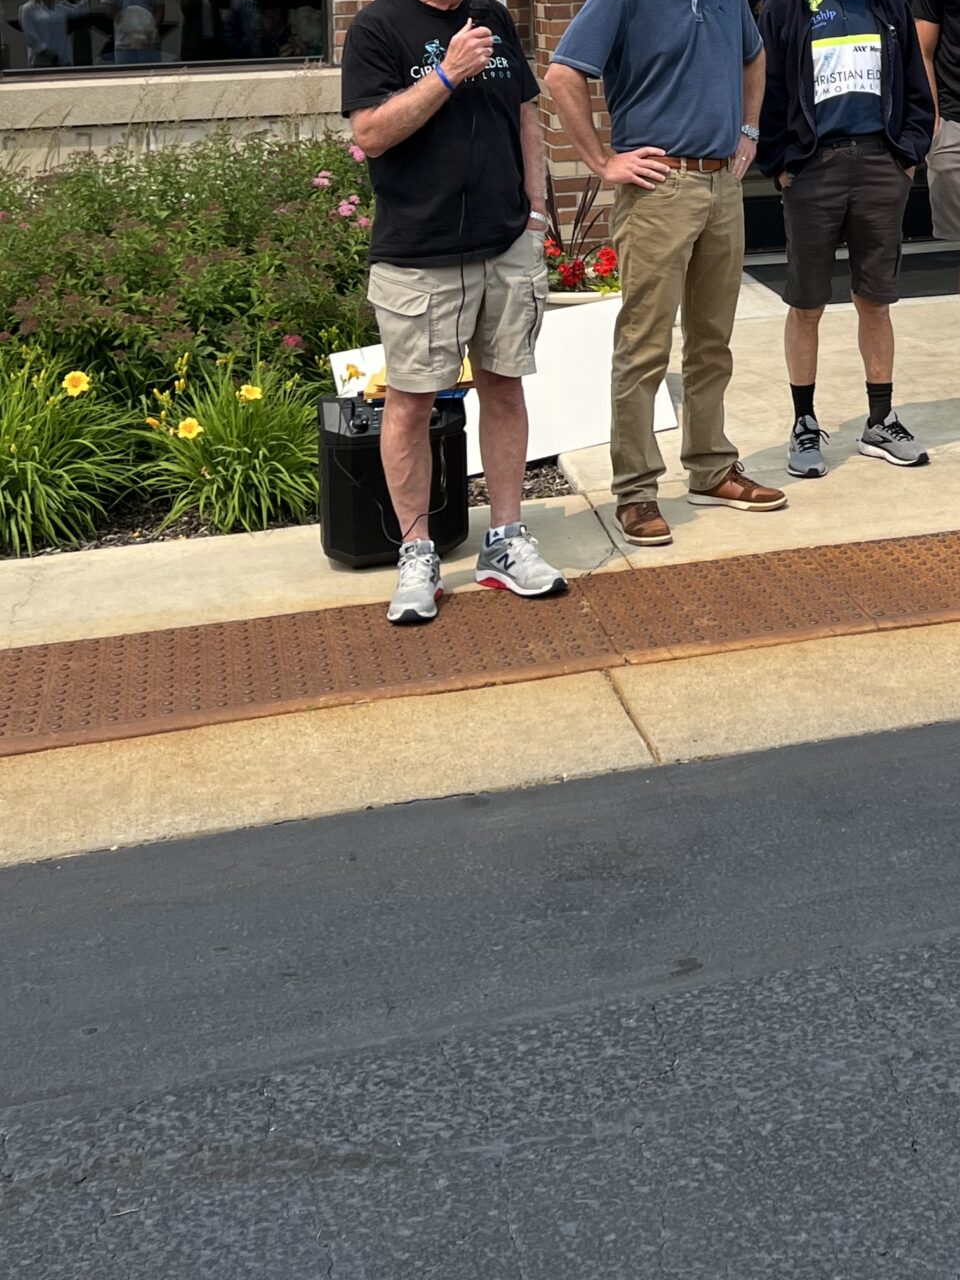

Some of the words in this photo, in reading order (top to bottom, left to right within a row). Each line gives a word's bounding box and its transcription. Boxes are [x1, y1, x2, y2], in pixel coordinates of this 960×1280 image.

[485, 56, 509, 68] DER
[814, 69, 863, 86] HRISTIAN
[867, 69, 881, 80] ELD
